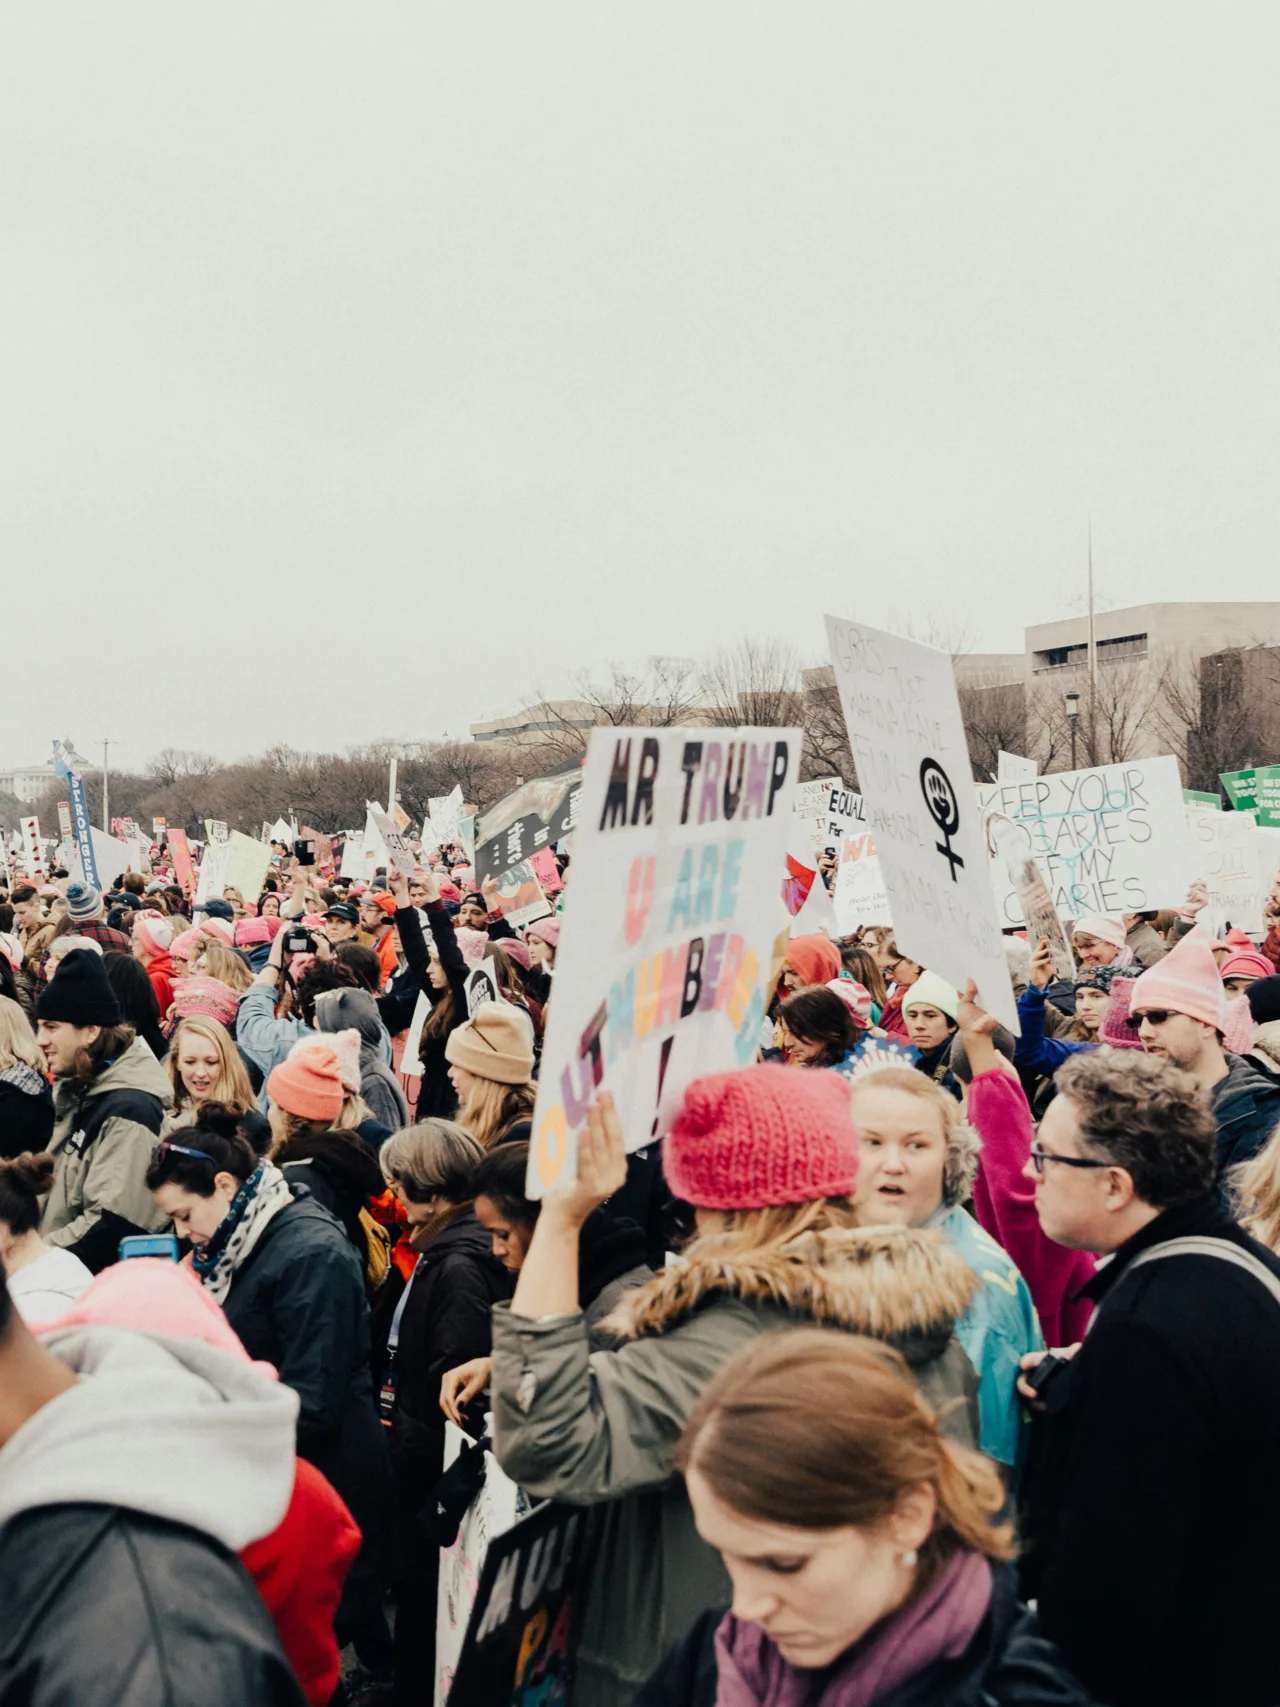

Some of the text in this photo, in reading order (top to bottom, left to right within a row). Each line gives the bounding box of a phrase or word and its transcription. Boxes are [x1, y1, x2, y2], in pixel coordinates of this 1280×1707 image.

[599, 737, 789, 832] MR TRUMP
[828, 788, 867, 822] EQUAL
[1060, 769, 1150, 814] YOUR
[71, 776, 97, 885] STRONGER
[992, 807, 1152, 852] OSARIES
[1080, 846, 1116, 882] MY
[623, 838, 746, 945] U ARE
[1003, 877, 1148, 924] OARIES
